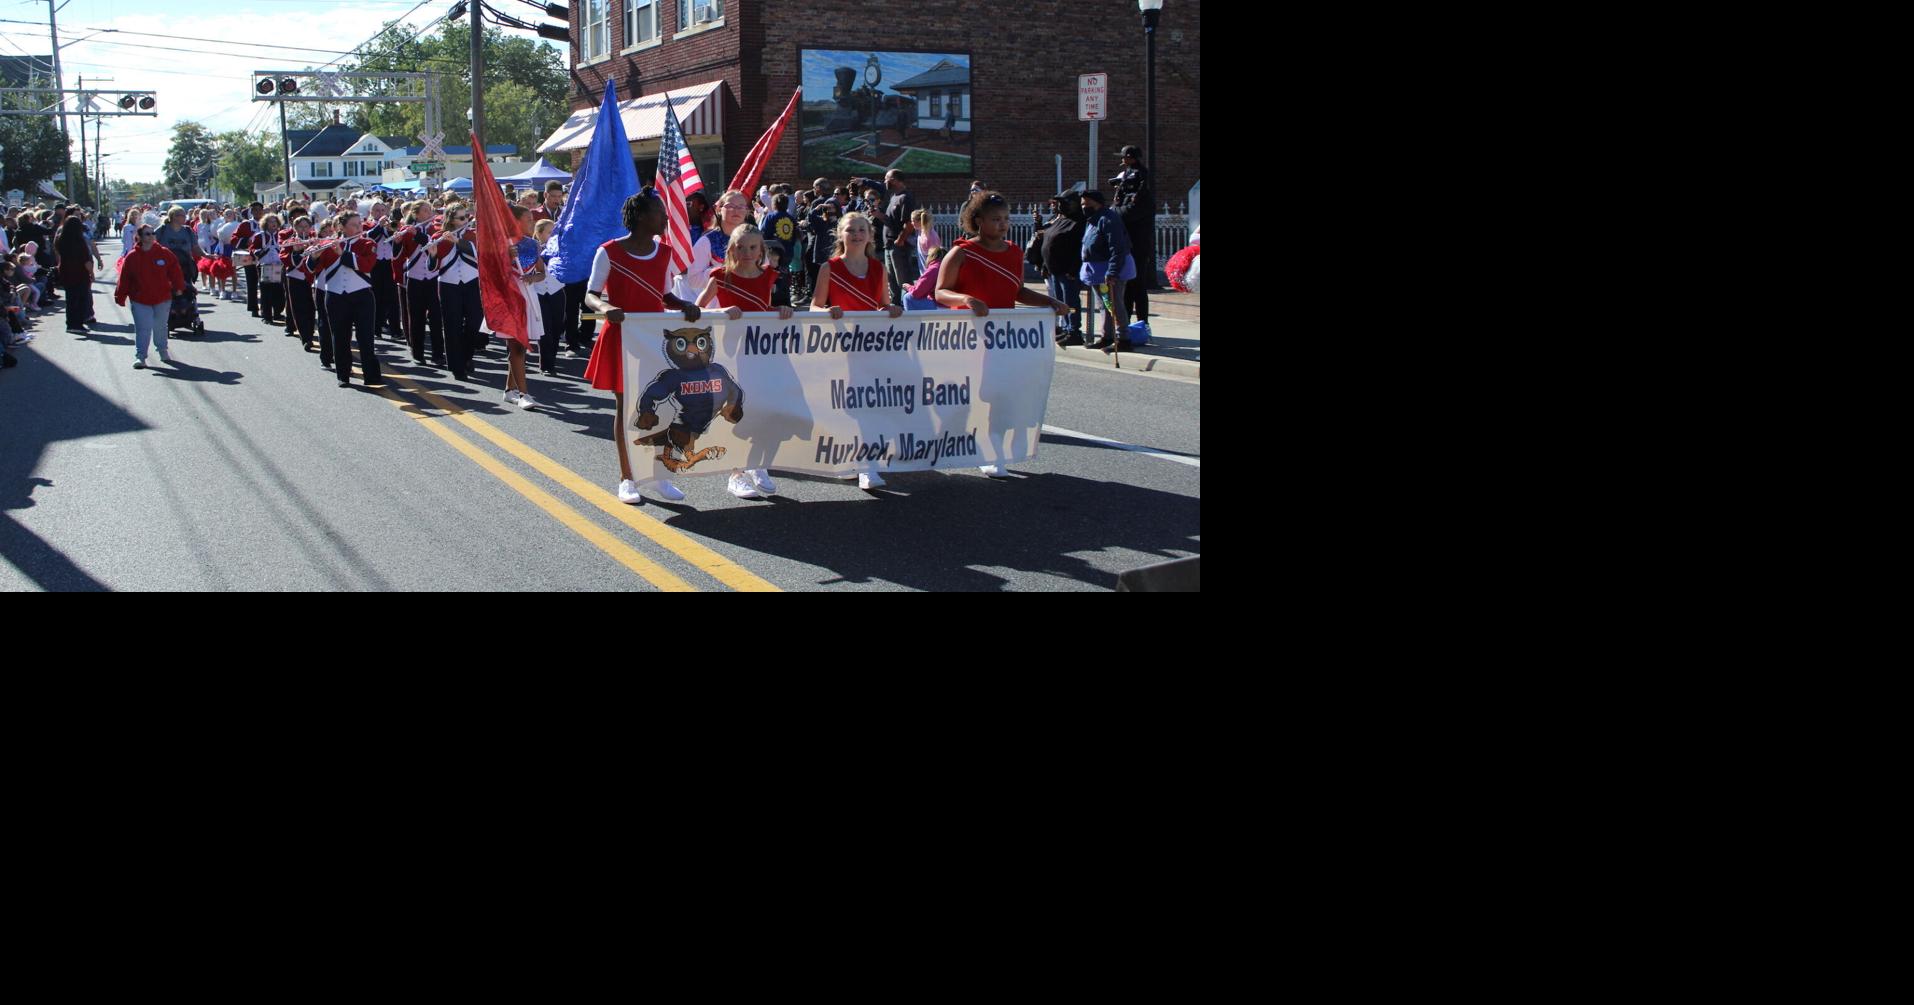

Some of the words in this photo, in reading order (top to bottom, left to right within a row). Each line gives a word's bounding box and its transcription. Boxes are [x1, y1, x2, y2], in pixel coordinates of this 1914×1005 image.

[1087, 77, 1098, 86] NO
[744, 325, 801, 355] North
[806, 324, 914, 354] Dorchester
[916, 321, 977, 351] Middle
[983, 320, 1045, 350] School
[680, 379, 723, 395] NDMS
[830, 377, 915, 415] Marching
[921, 376, 970, 406] Band
[815, 434, 894, 467] Hurlock,
[898, 428, 977, 466] Maryland
